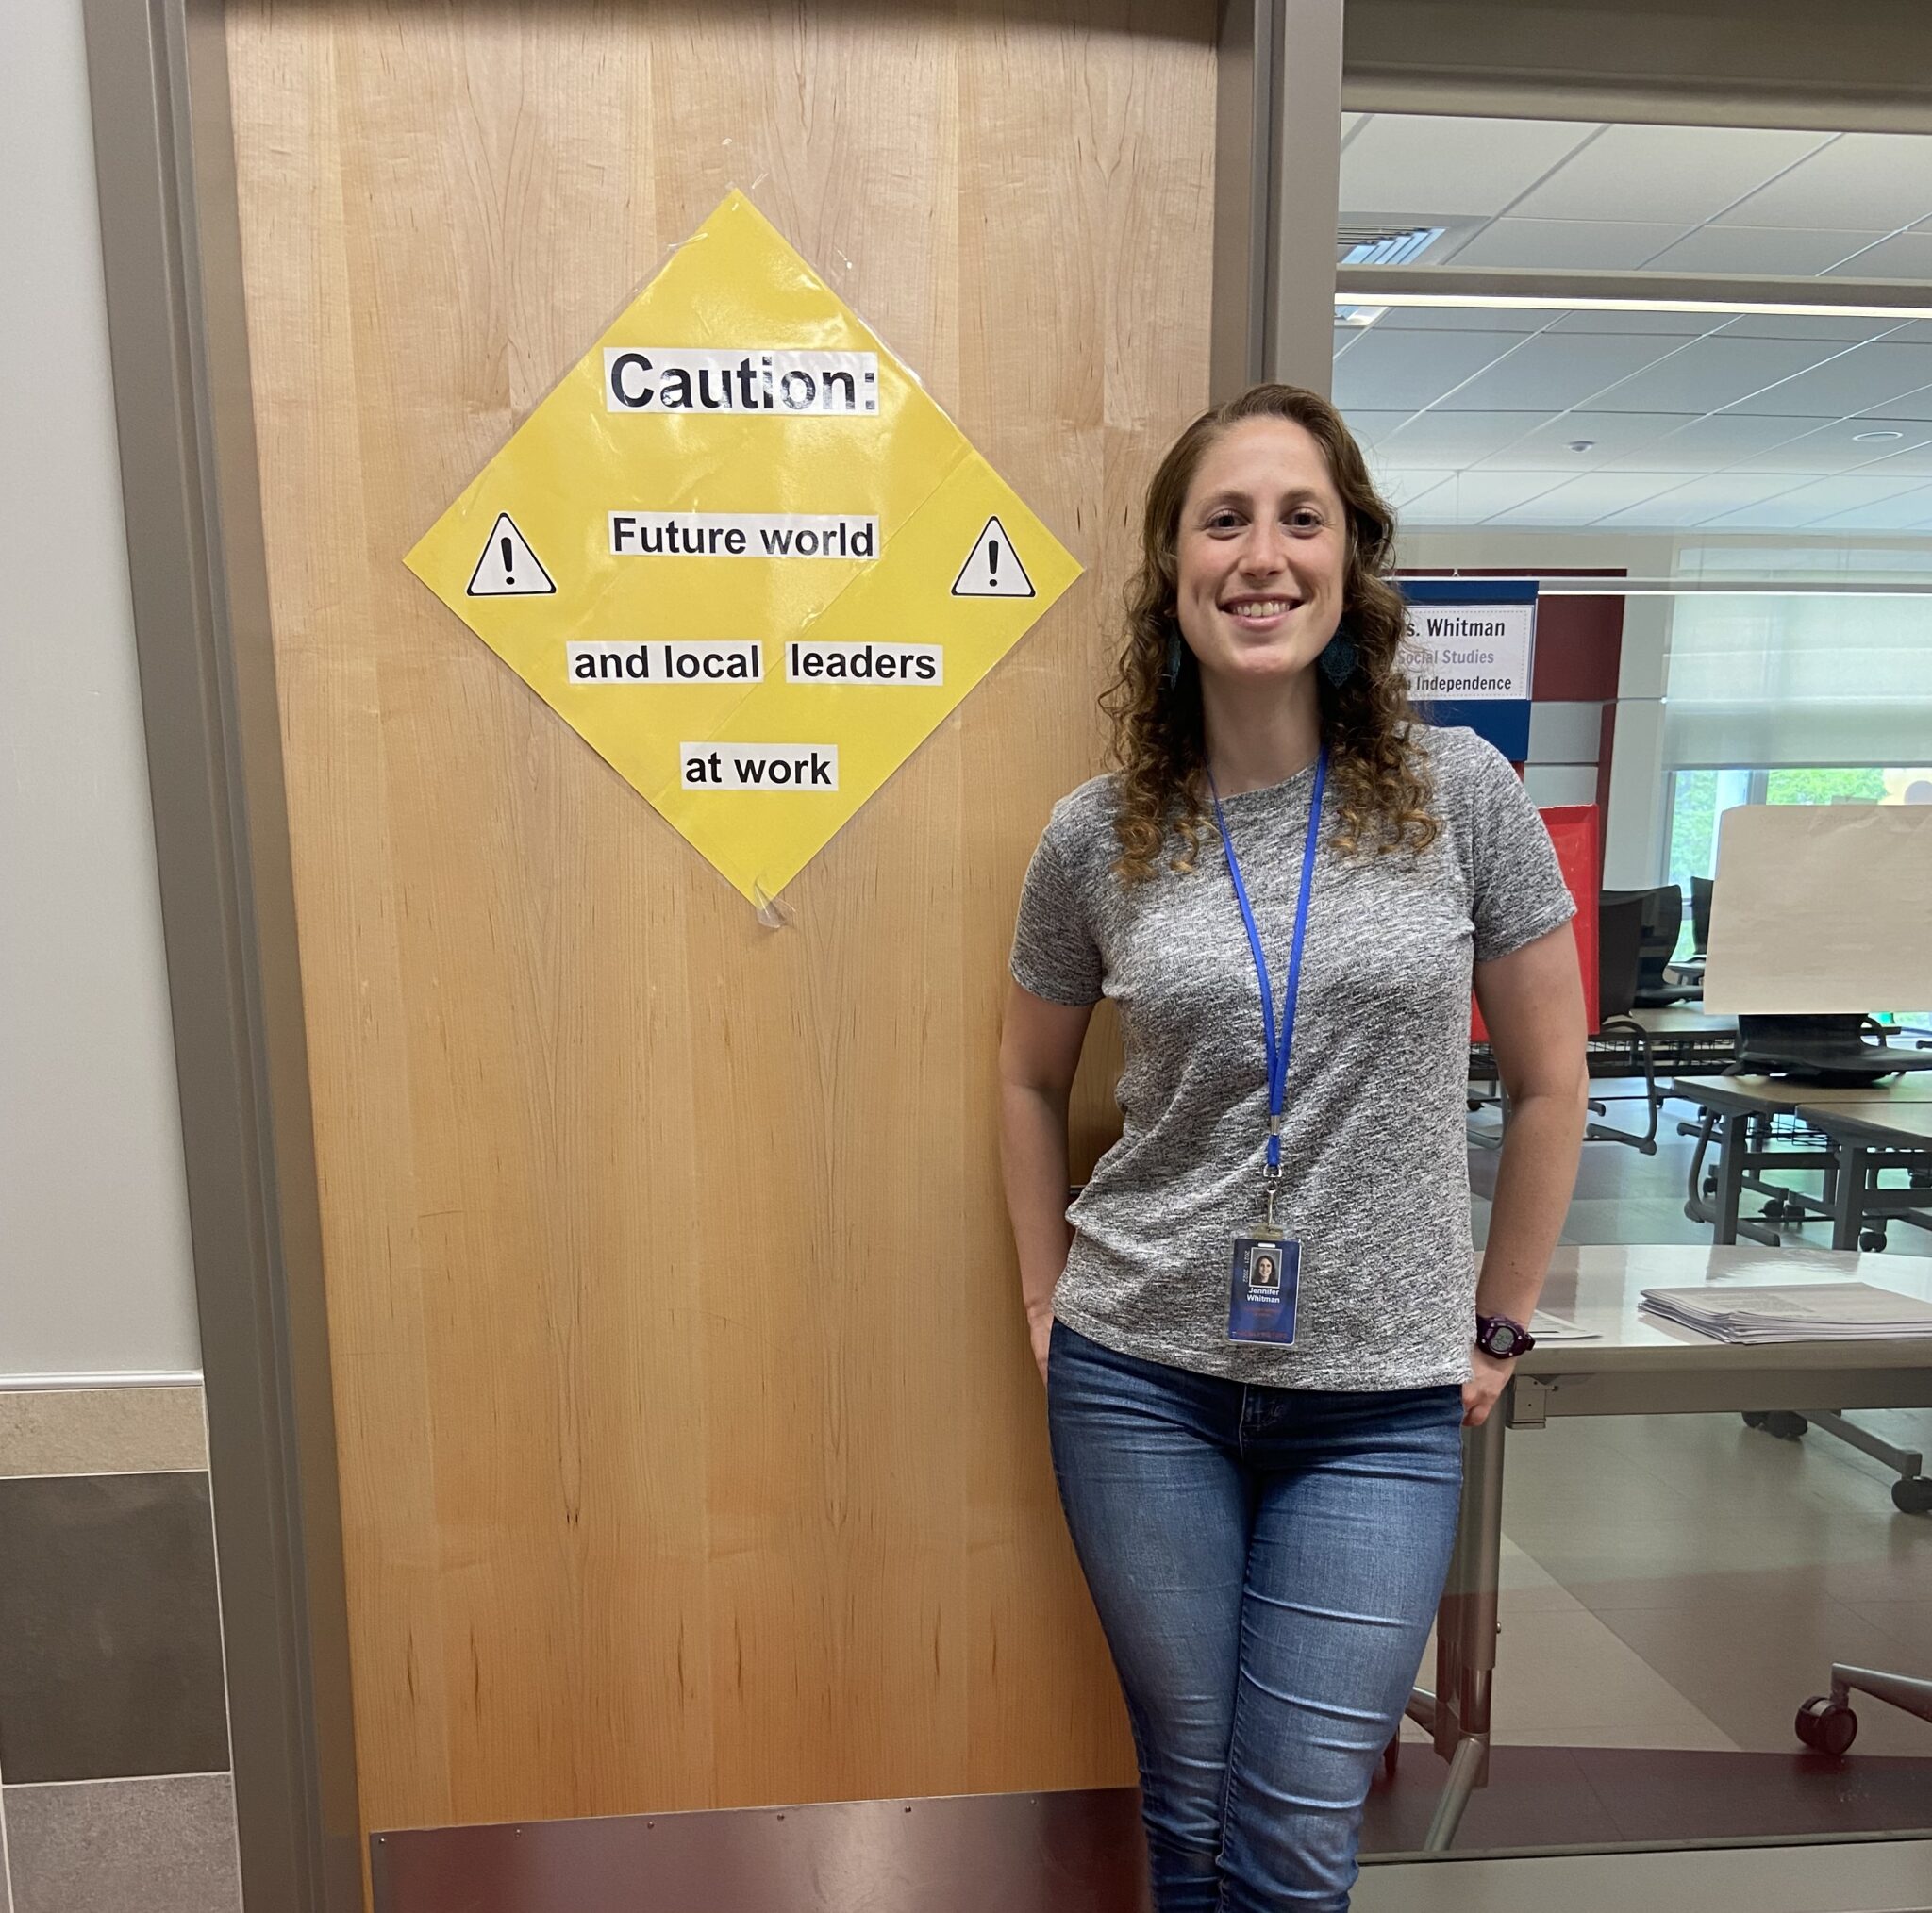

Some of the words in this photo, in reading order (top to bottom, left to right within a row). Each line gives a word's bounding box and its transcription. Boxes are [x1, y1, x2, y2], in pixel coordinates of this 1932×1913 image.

[610, 353, 875, 409] Caution:
[613, 517, 746, 554] Future
[760, 523, 874, 557] world
[1427, 618, 1505, 637] Whitman
[575, 645, 649, 679] and
[665, 645, 759, 678] local
[791, 644, 936, 679] leaders
[1398, 650, 1439, 665] Social
[1442, 649, 1494, 664] Studies
[1417, 676, 1512, 692] Independence
[686, 753, 722, 783] at
[734, 753, 831, 785] work
[1247, 1294, 1280, 1303] Whitman
